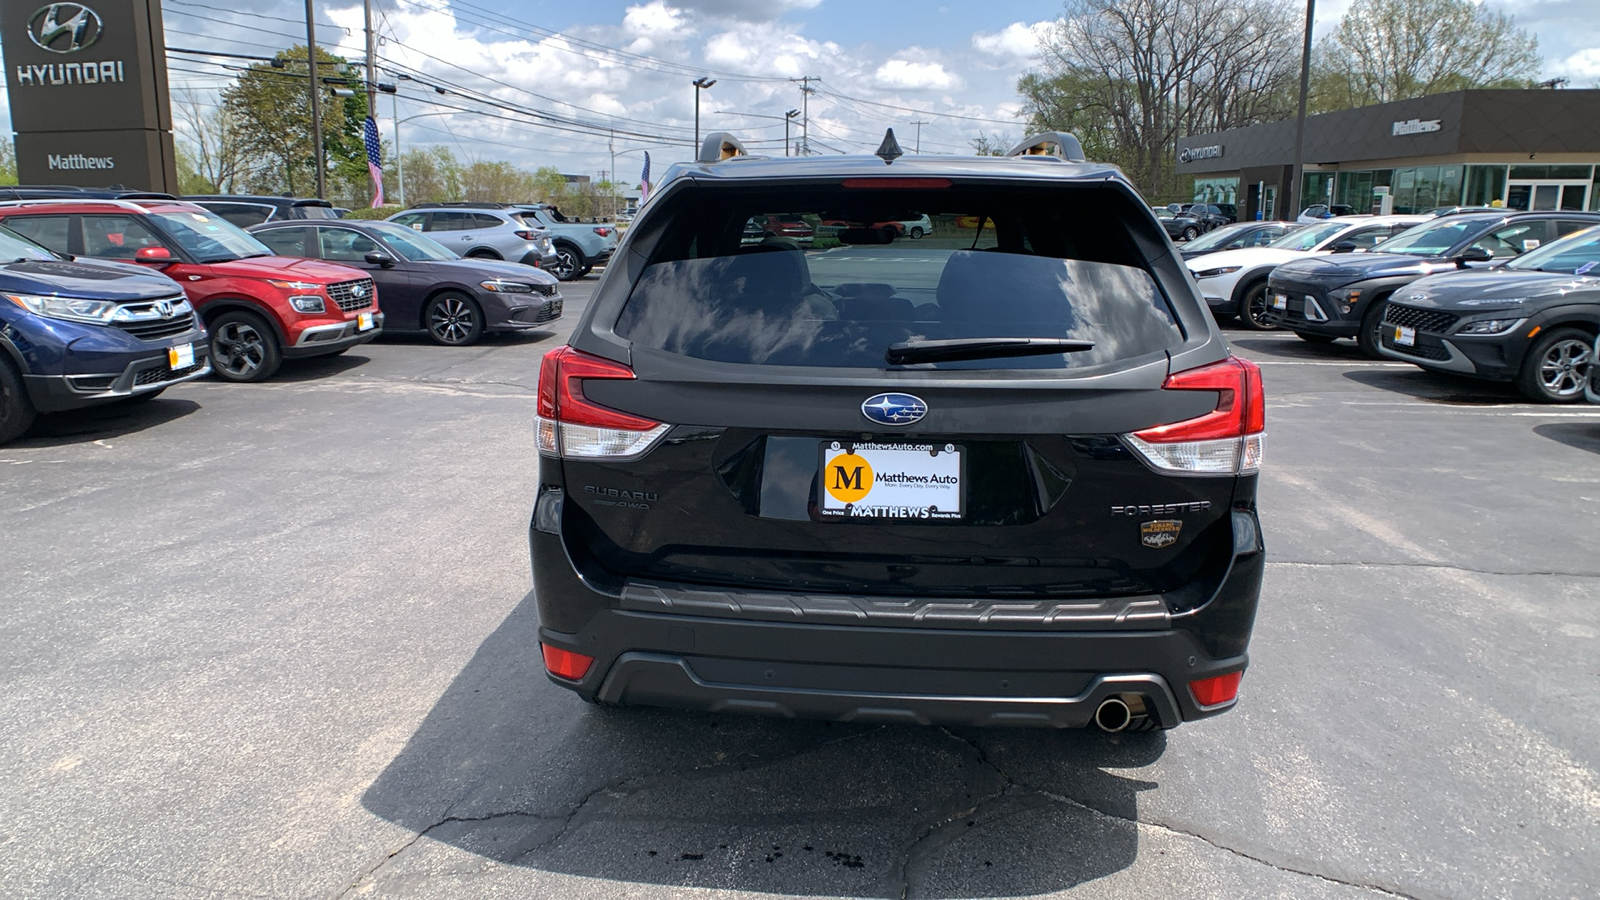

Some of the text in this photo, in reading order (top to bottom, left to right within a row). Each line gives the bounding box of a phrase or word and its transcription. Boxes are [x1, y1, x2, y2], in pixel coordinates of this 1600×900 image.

[17, 61, 124, 86] HYUNDAI
[1191, 145, 1222, 160] HYUNDAI
[48, 154, 114, 169] Matthews
[852, 442, 933, 451] MatthewsAuto.com
[832, 465, 865, 490] M
[875, 472, 958, 484] Matthews Auto
[584, 485, 658, 501] SUBARU
[612, 501, 650, 510] AWD
[850, 506, 930, 519] MATTHEWS
[1111, 501, 1212, 516] FORESTER
